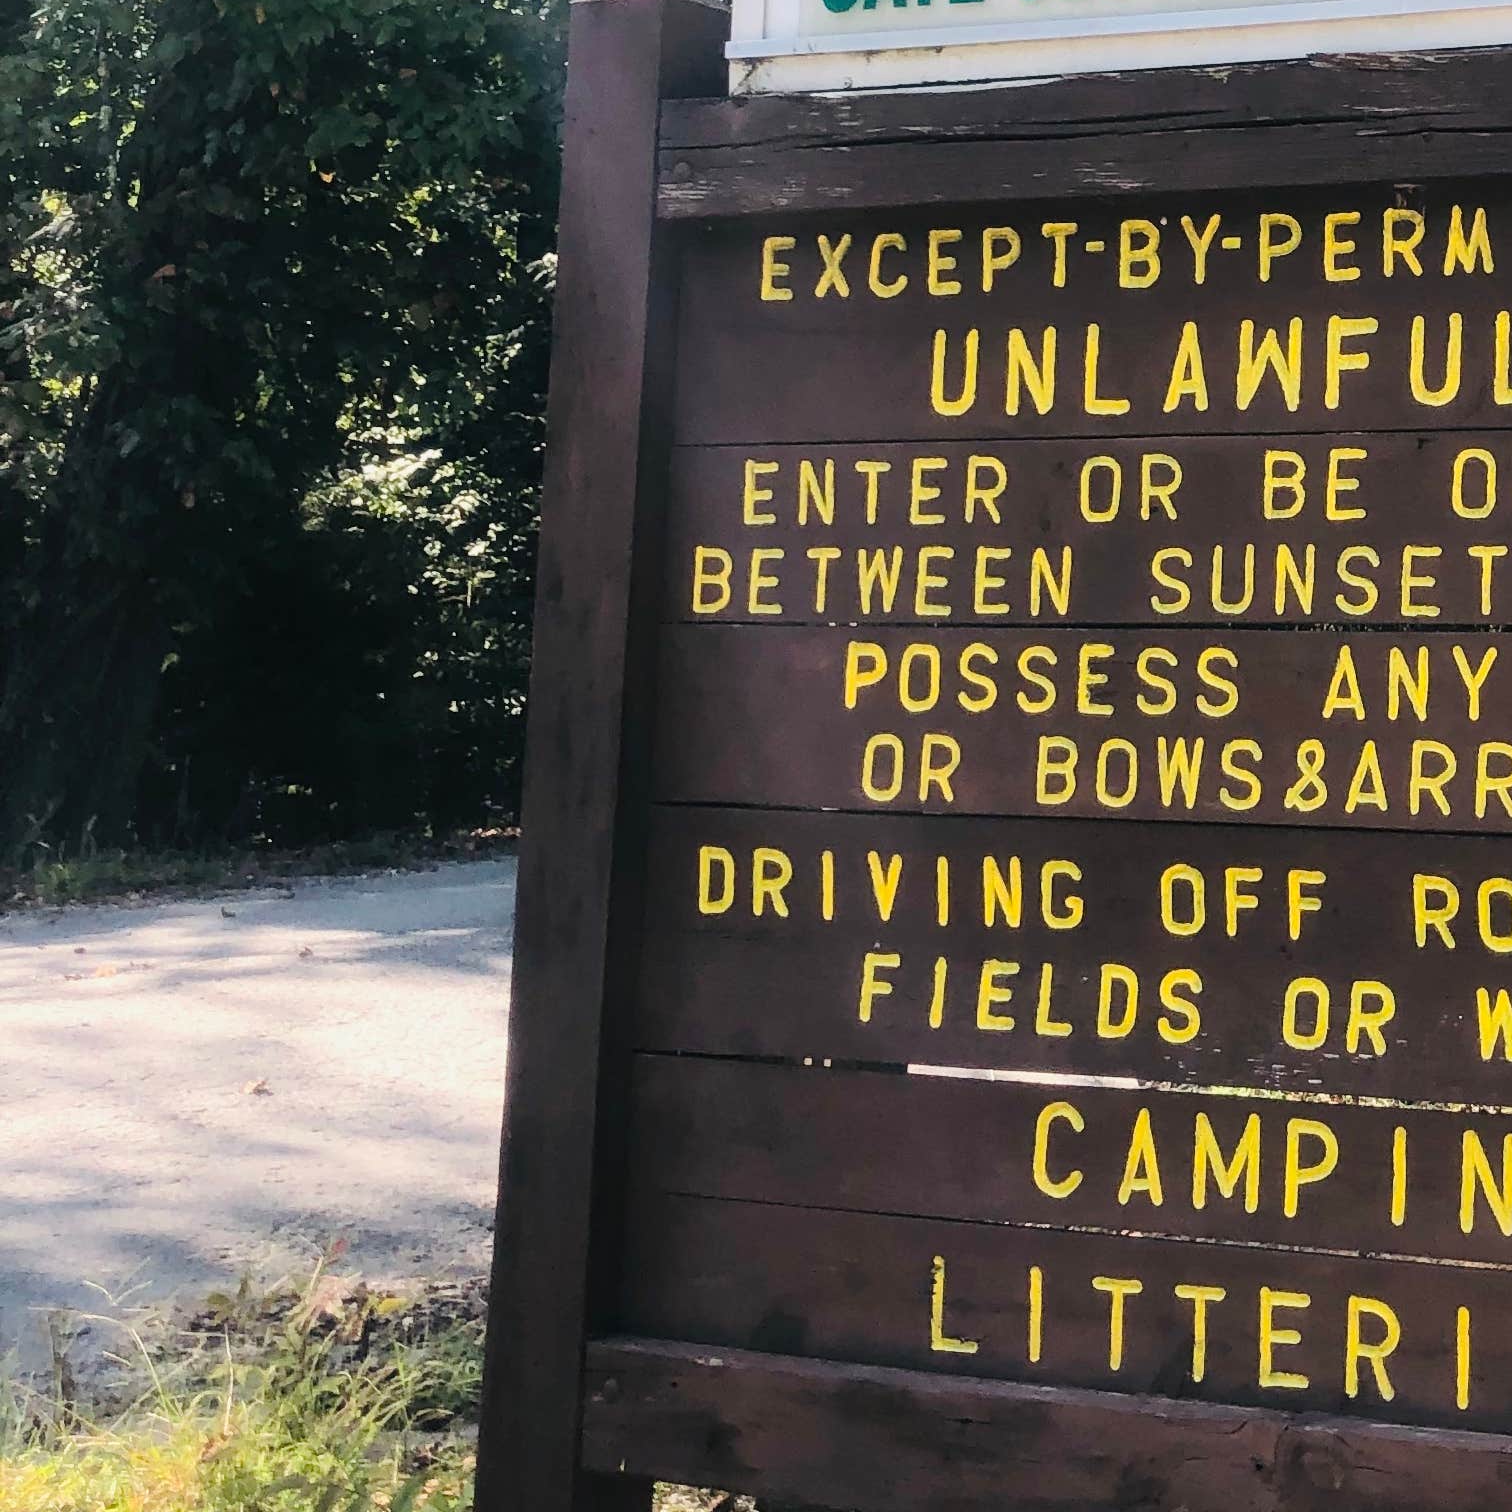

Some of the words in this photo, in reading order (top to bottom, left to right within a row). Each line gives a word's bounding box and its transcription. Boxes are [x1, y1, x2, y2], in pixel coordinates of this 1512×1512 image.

[741, 453, 1009, 527] ENTER
[1078, 452, 1184, 524] OR
[1262, 446, 1369, 522] BE
[691, 544, 1074, 618] BETWEEN
[842, 639, 1240, 719] POSSESS
[1320, 643, 1499, 723] ANY
[860, 731, 962, 805] OR
[697, 844, 1085, 931] DRIVING
[1159, 862, 1328, 942] OFF
[857, 951, 1204, 1047] FIELDS
[1281, 975, 1397, 1058] OR
